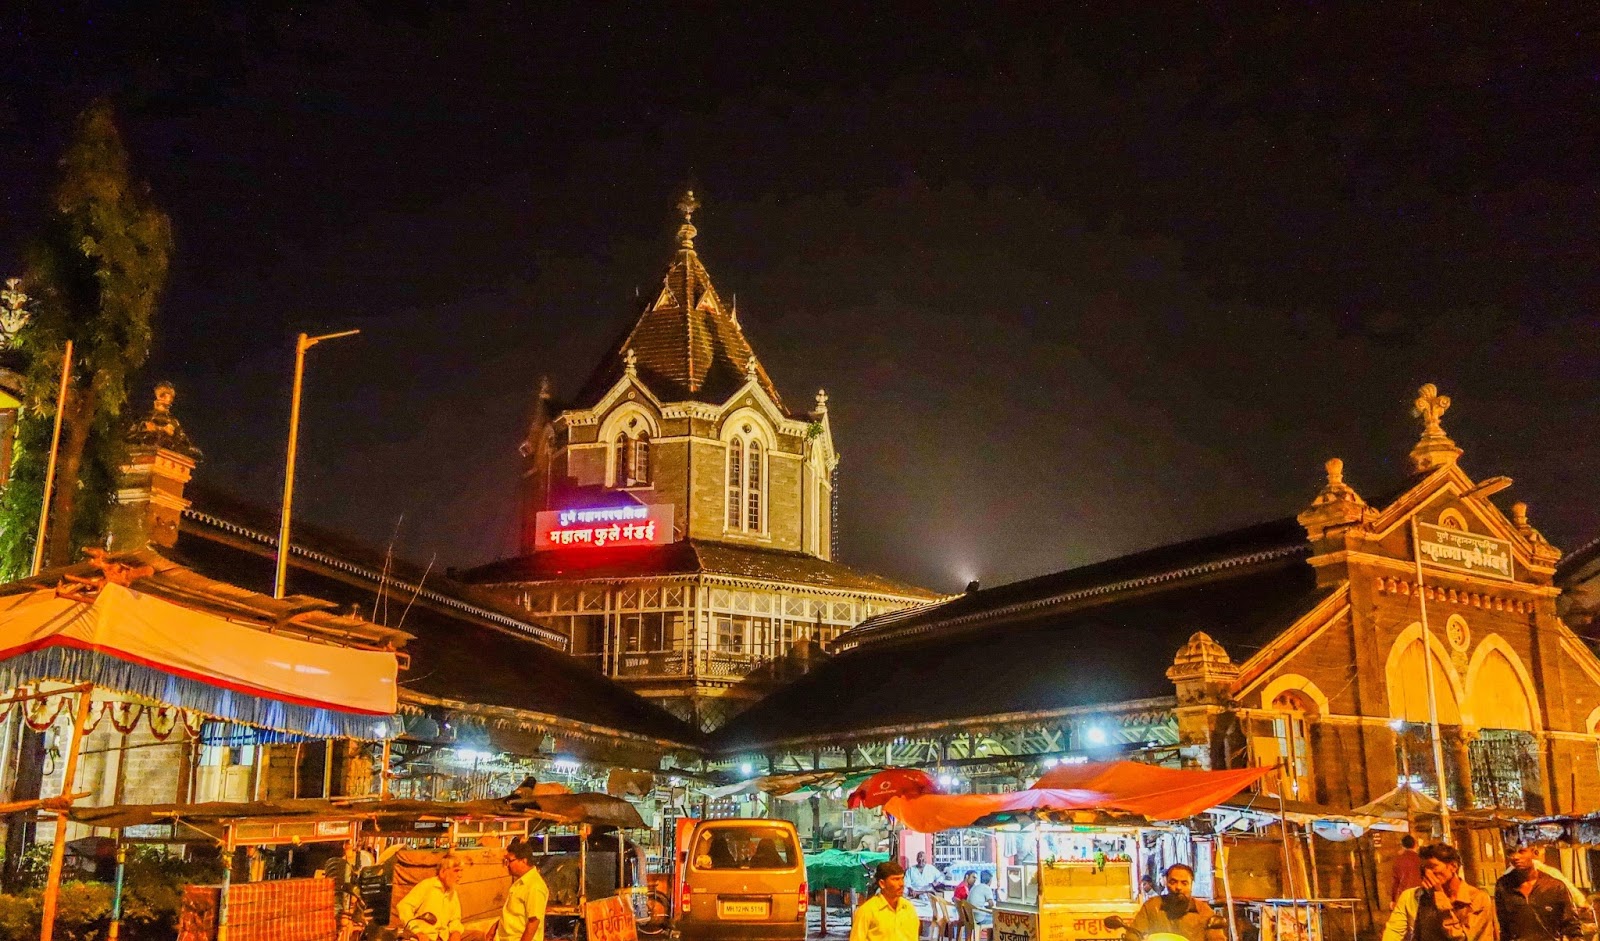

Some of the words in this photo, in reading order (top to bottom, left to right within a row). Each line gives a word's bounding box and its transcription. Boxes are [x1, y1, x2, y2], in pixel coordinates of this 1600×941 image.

[560, 509, 577, 526] पुणे
[550, 529, 593, 544] महात्मा
[594, 523, 621, 546] फुले
[623, 520, 655, 541] मंडई
[1436, 531, 1449, 543] पुणे
[1420, 540, 1462, 562] महात्मा
[1461, 547, 1483, 569] फुले
[1482, 549, 1509, 575] मंडई
